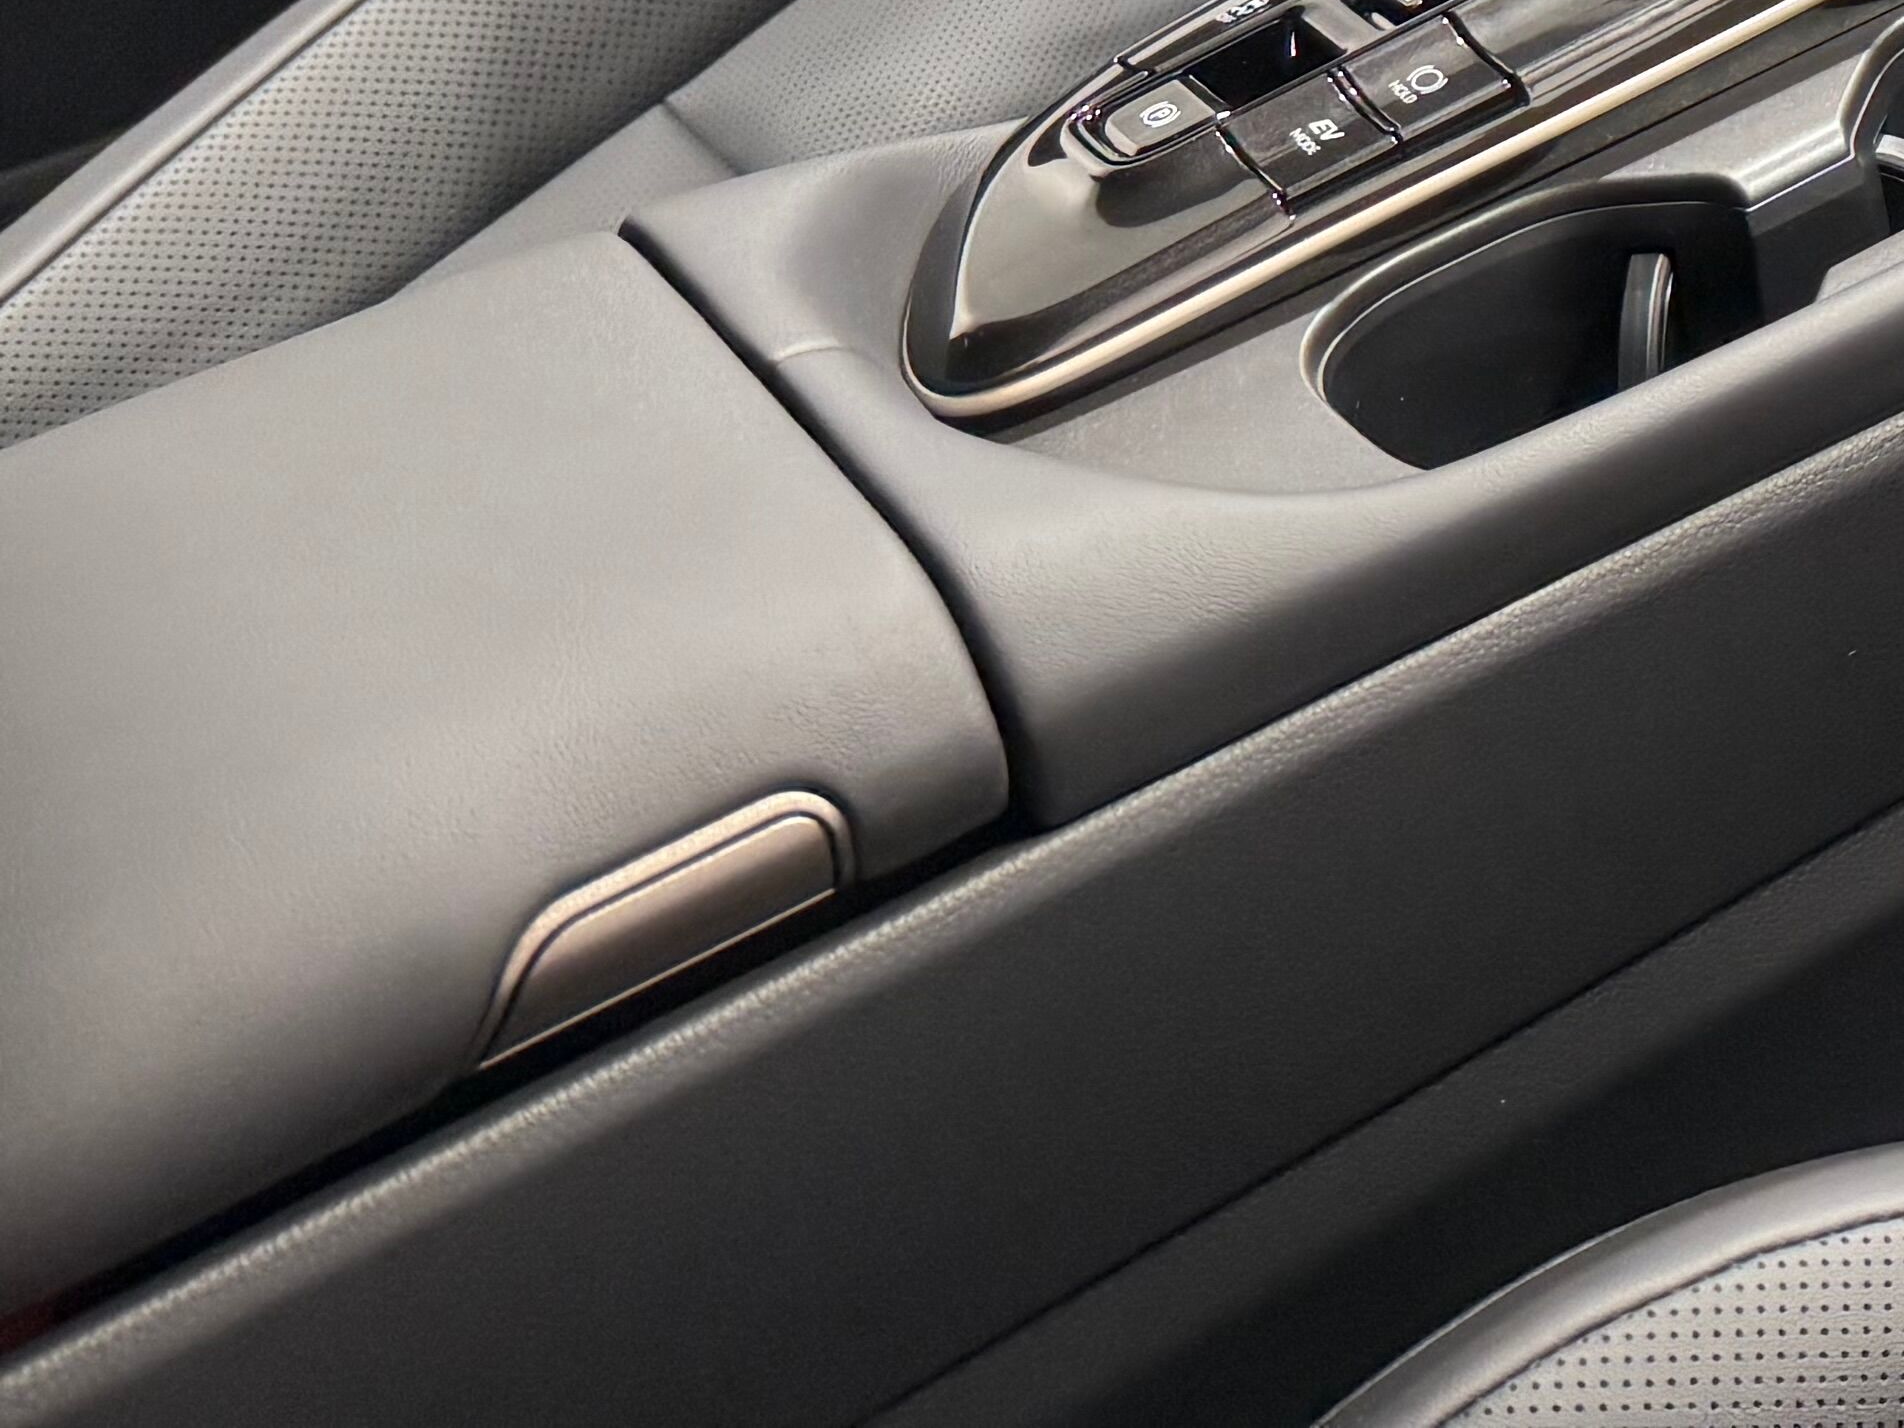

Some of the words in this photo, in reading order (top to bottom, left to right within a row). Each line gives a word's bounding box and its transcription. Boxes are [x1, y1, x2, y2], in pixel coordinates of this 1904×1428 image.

[1388, 79, 1419, 104] HOLD
[1289, 127, 1321, 155] MODE
[1308, 118, 1345, 141] EV
